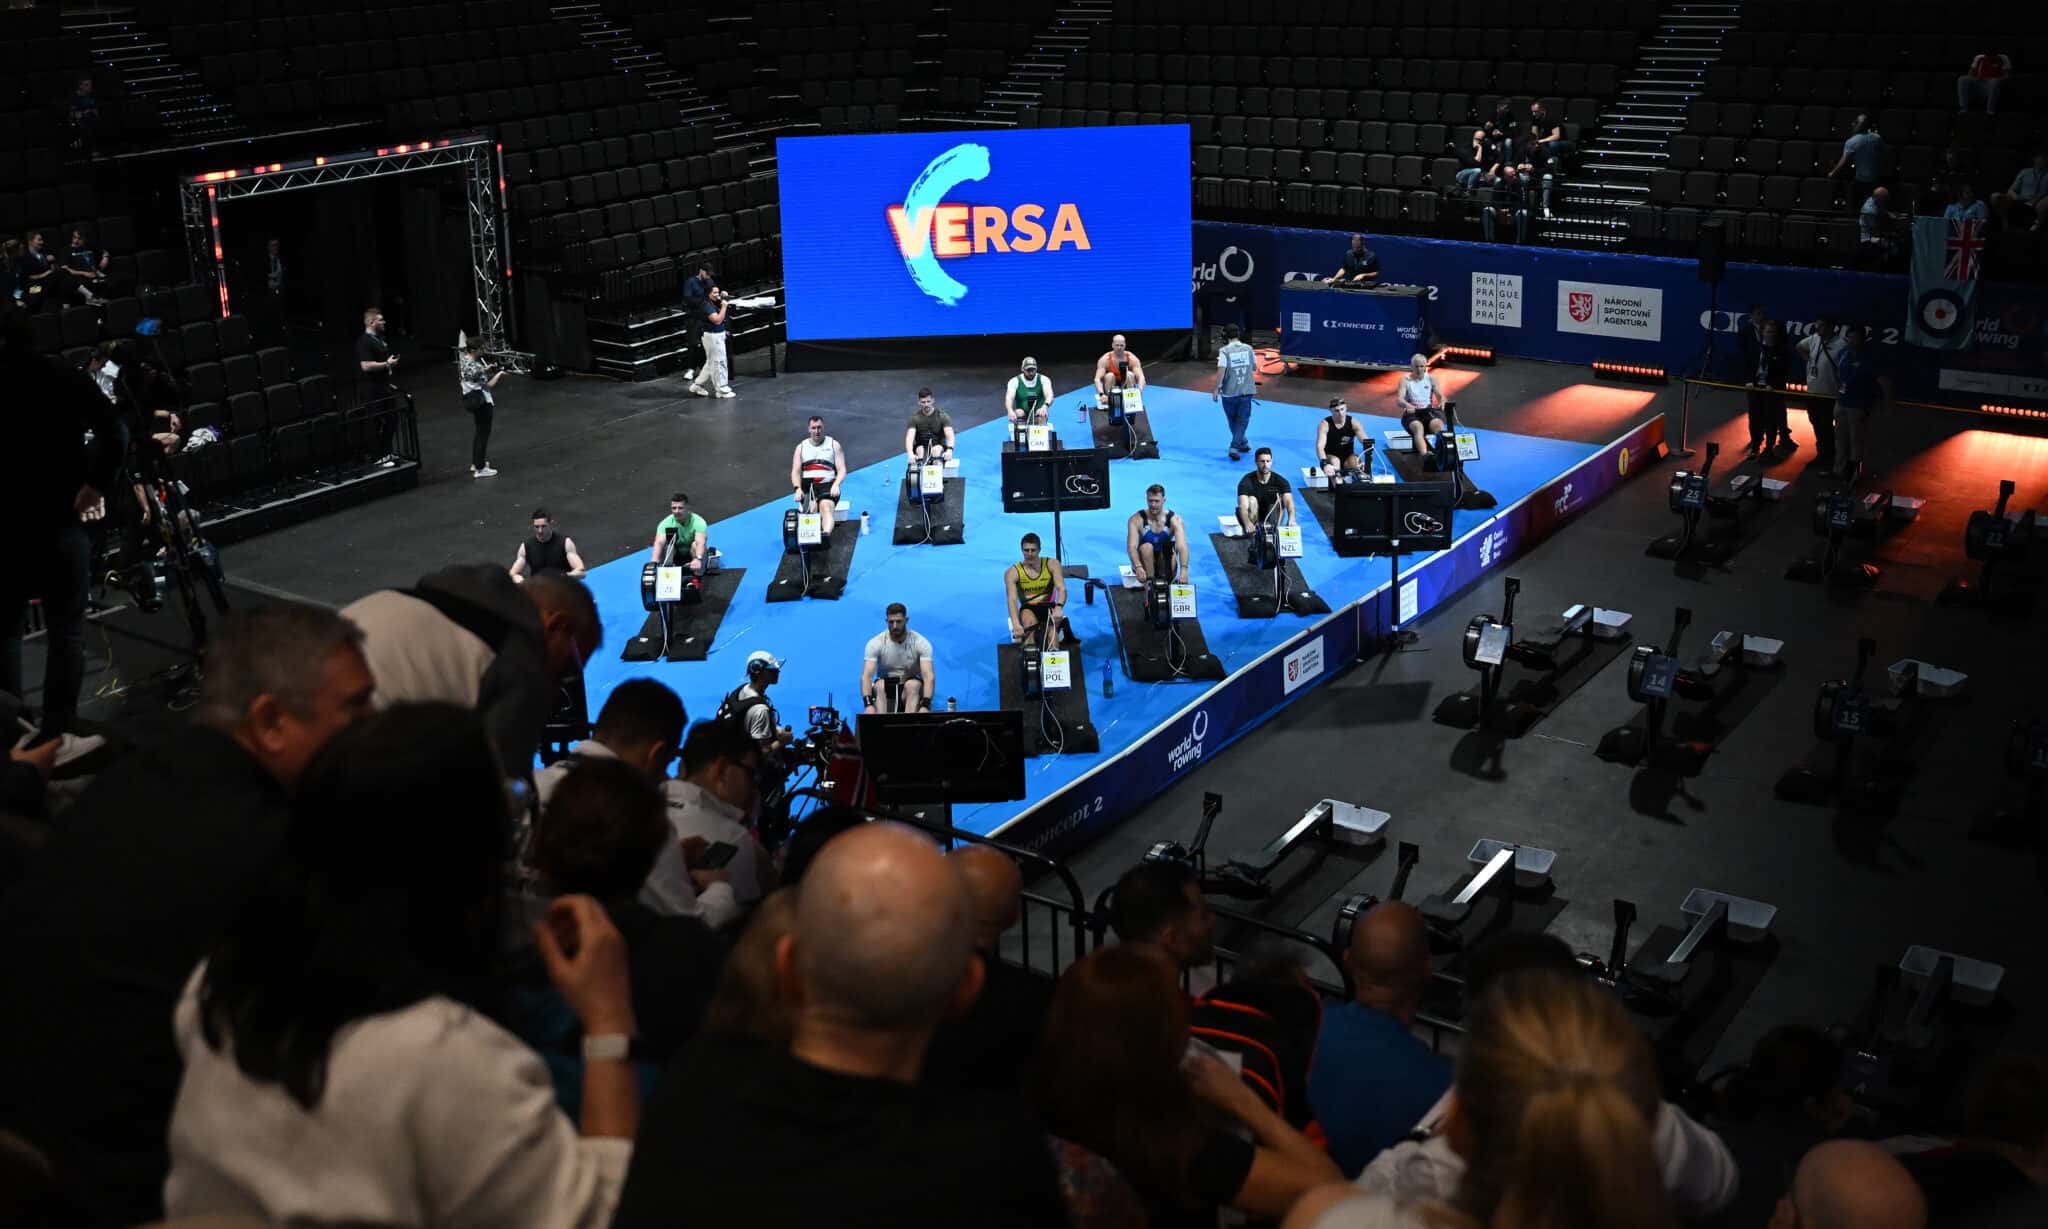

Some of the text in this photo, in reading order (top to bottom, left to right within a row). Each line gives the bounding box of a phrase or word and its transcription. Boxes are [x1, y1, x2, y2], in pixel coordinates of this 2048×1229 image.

[886, 203, 1092, 258] VERSA
[1192, 262, 1217, 281] rld
[1604, 297, 1642, 308] NÁRODNÍ
[1603, 306, 1651, 319] SPORTOVNÍ
[1603, 317, 1648, 328] AGENTURA
[1976, 316, 2001, 331] rld
[1975, 333, 2019, 351] wing
[1281, 544, 1297, 552] NZL
[1173, 604, 1191, 613] GBR
[1050, 656, 1057, 665] 2
[1045, 673, 1065, 682] POL
[1168, 732, 1192, 763] world
[1173, 742, 1202, 773] rowing
[1094, 796, 1104, 813] 2
